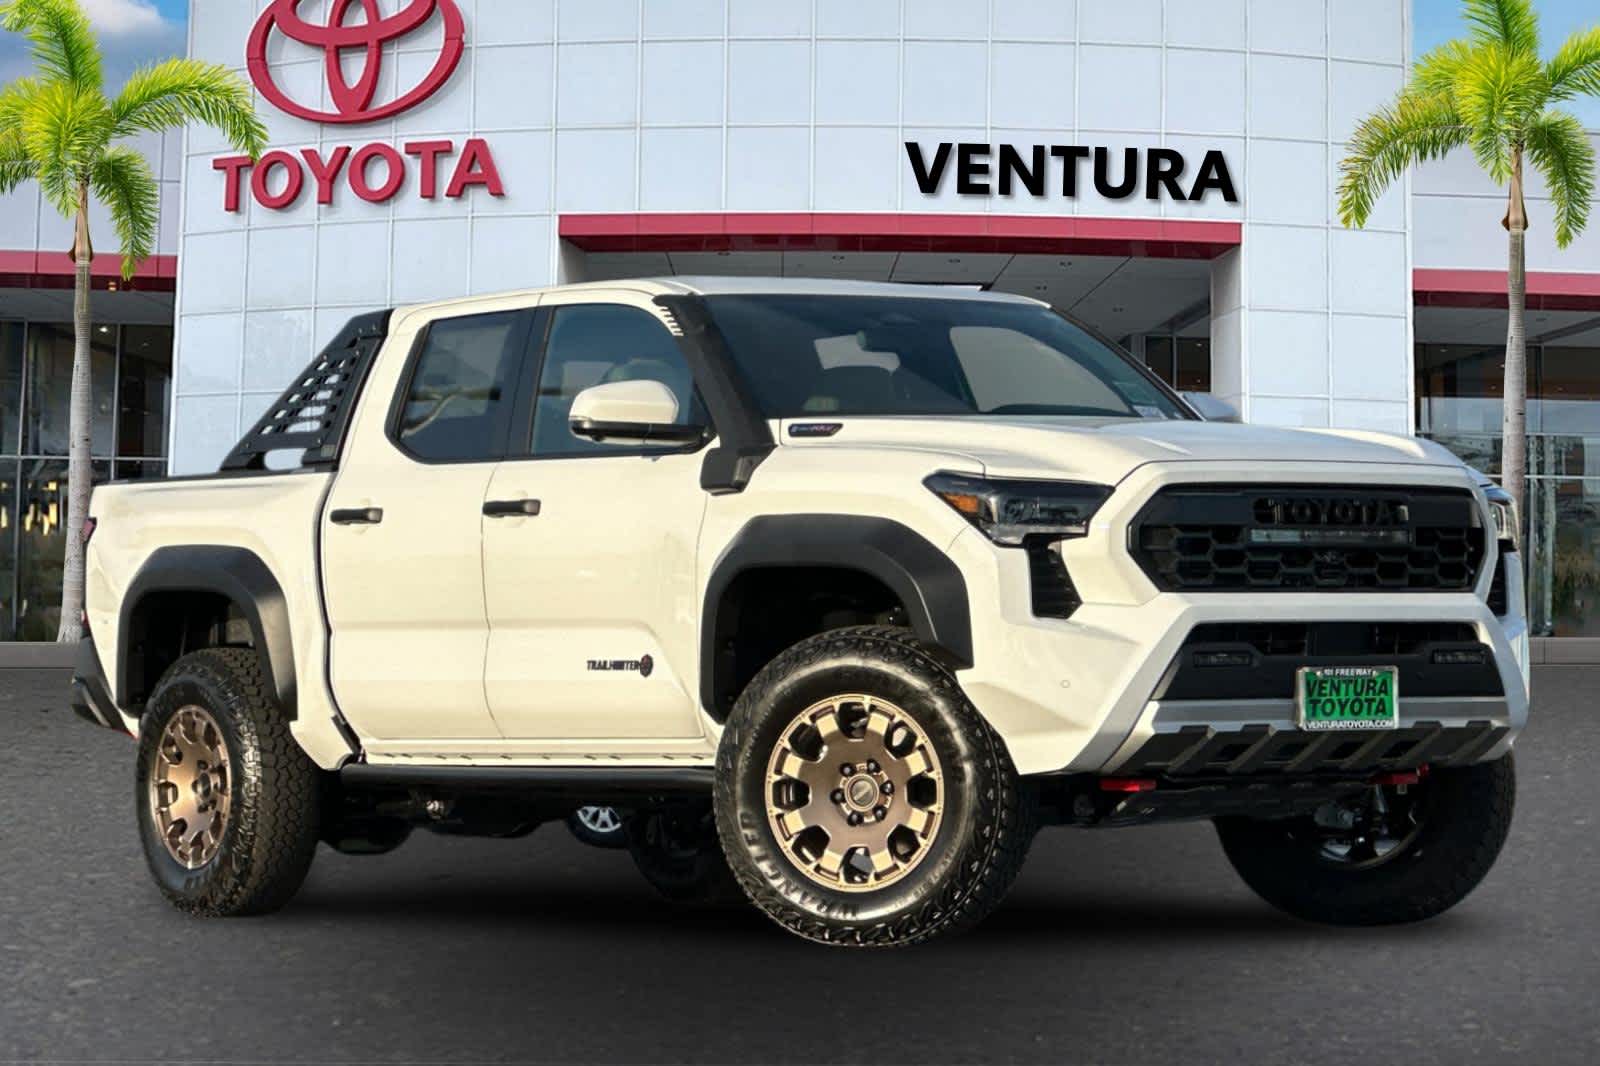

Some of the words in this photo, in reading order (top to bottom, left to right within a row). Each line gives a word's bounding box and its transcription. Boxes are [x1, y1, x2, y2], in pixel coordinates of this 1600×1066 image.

[212, 138, 505, 212] TOYOTA
[904, 141, 1238, 202] VENTURA
[1266, 498, 1398, 527] TOYOTA
[1335, 668, 1372, 676] FREEWAY
[1306, 679, 1389, 697] VENTURA
[1308, 698, 1387, 717] TOYOTA
[1306, 719, 1393, 729] VENTURATOYOTA.COM
